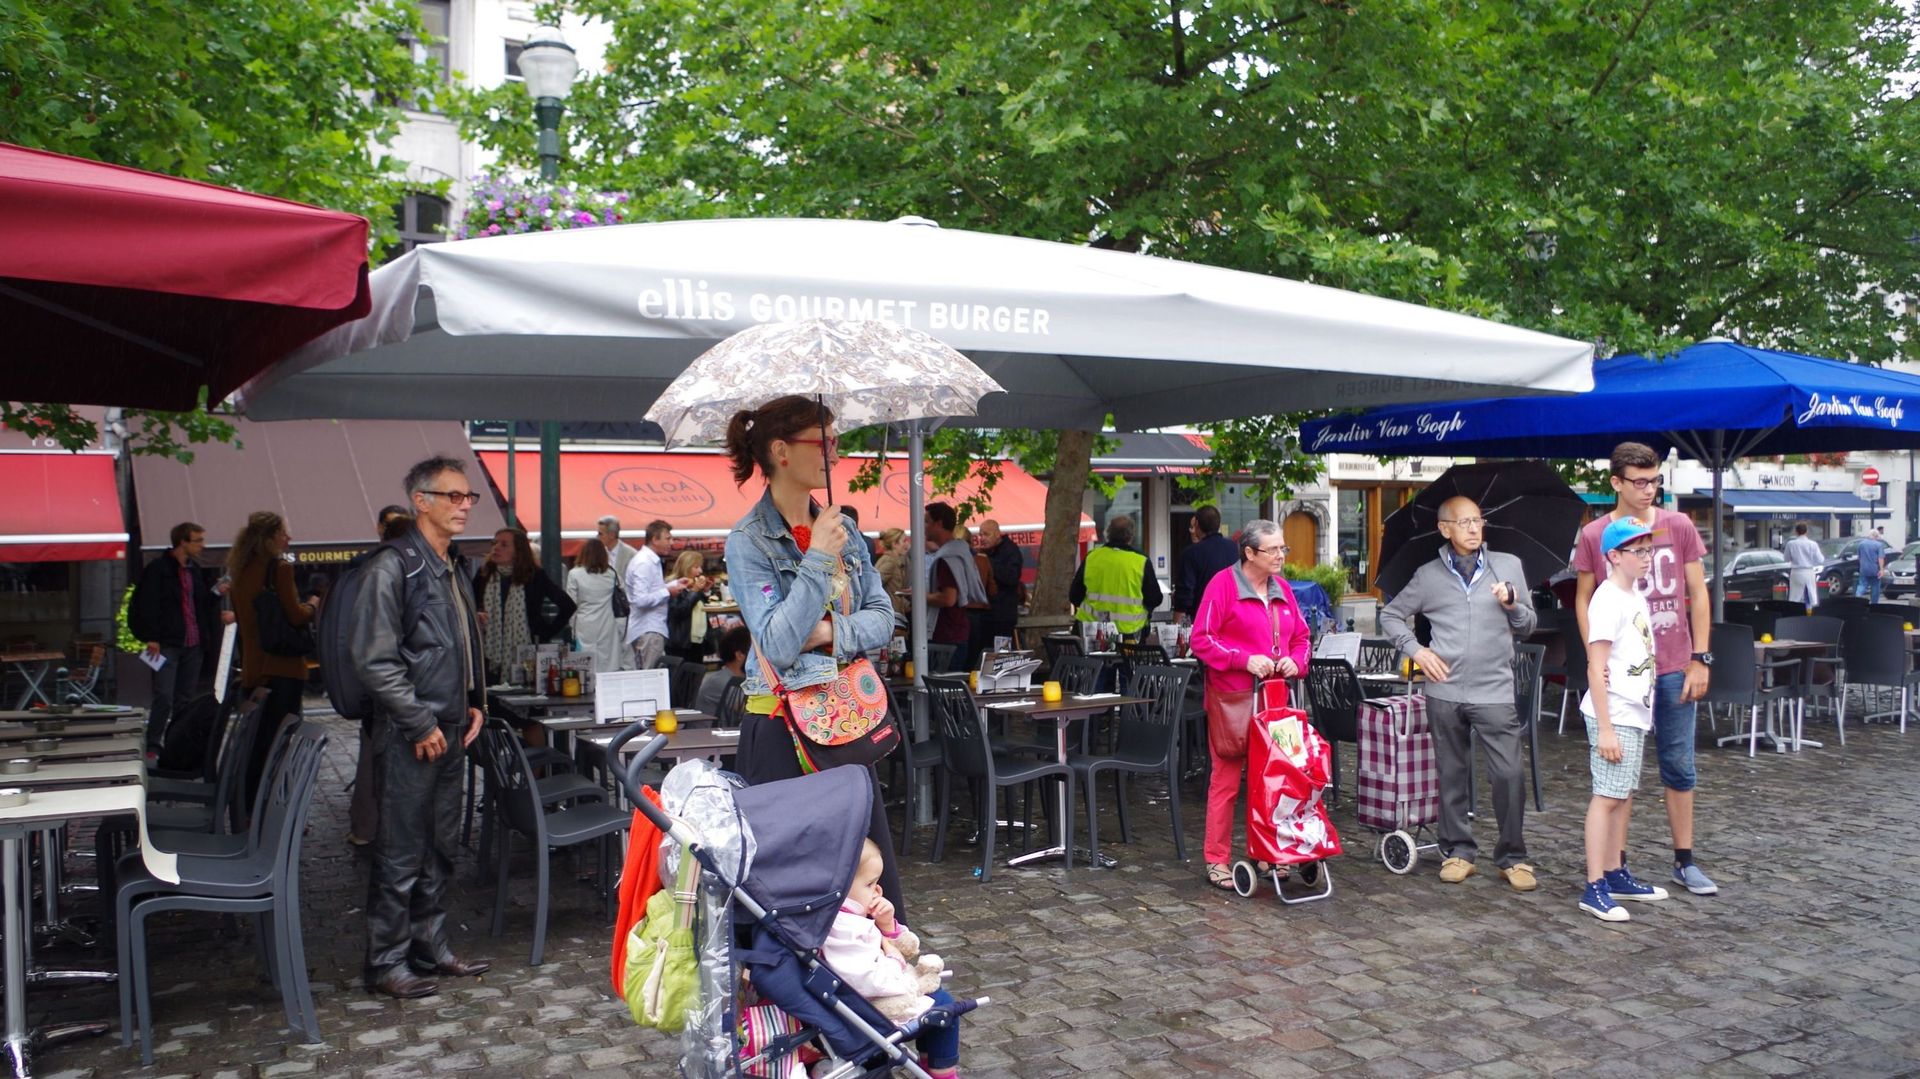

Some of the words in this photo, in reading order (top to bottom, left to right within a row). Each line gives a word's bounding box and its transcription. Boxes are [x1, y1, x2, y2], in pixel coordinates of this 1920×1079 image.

[637, 277, 735, 321] ellis
[749, 293, 917, 327] GOURMET
[929, 302, 1050, 336] BURGER
[1797, 392, 1852, 425] Jardin
[1848, 395, 1875, 418] Van
[1874, 396, 1904, 428] Gogh
[1312, 423, 1374, 451] Jardin
[1376, 417, 1412, 439] Van
[1416, 410, 1467, 442] Gogh
[618, 481, 690, 493] JALOA
[299, 551, 359, 562] GOURMET
